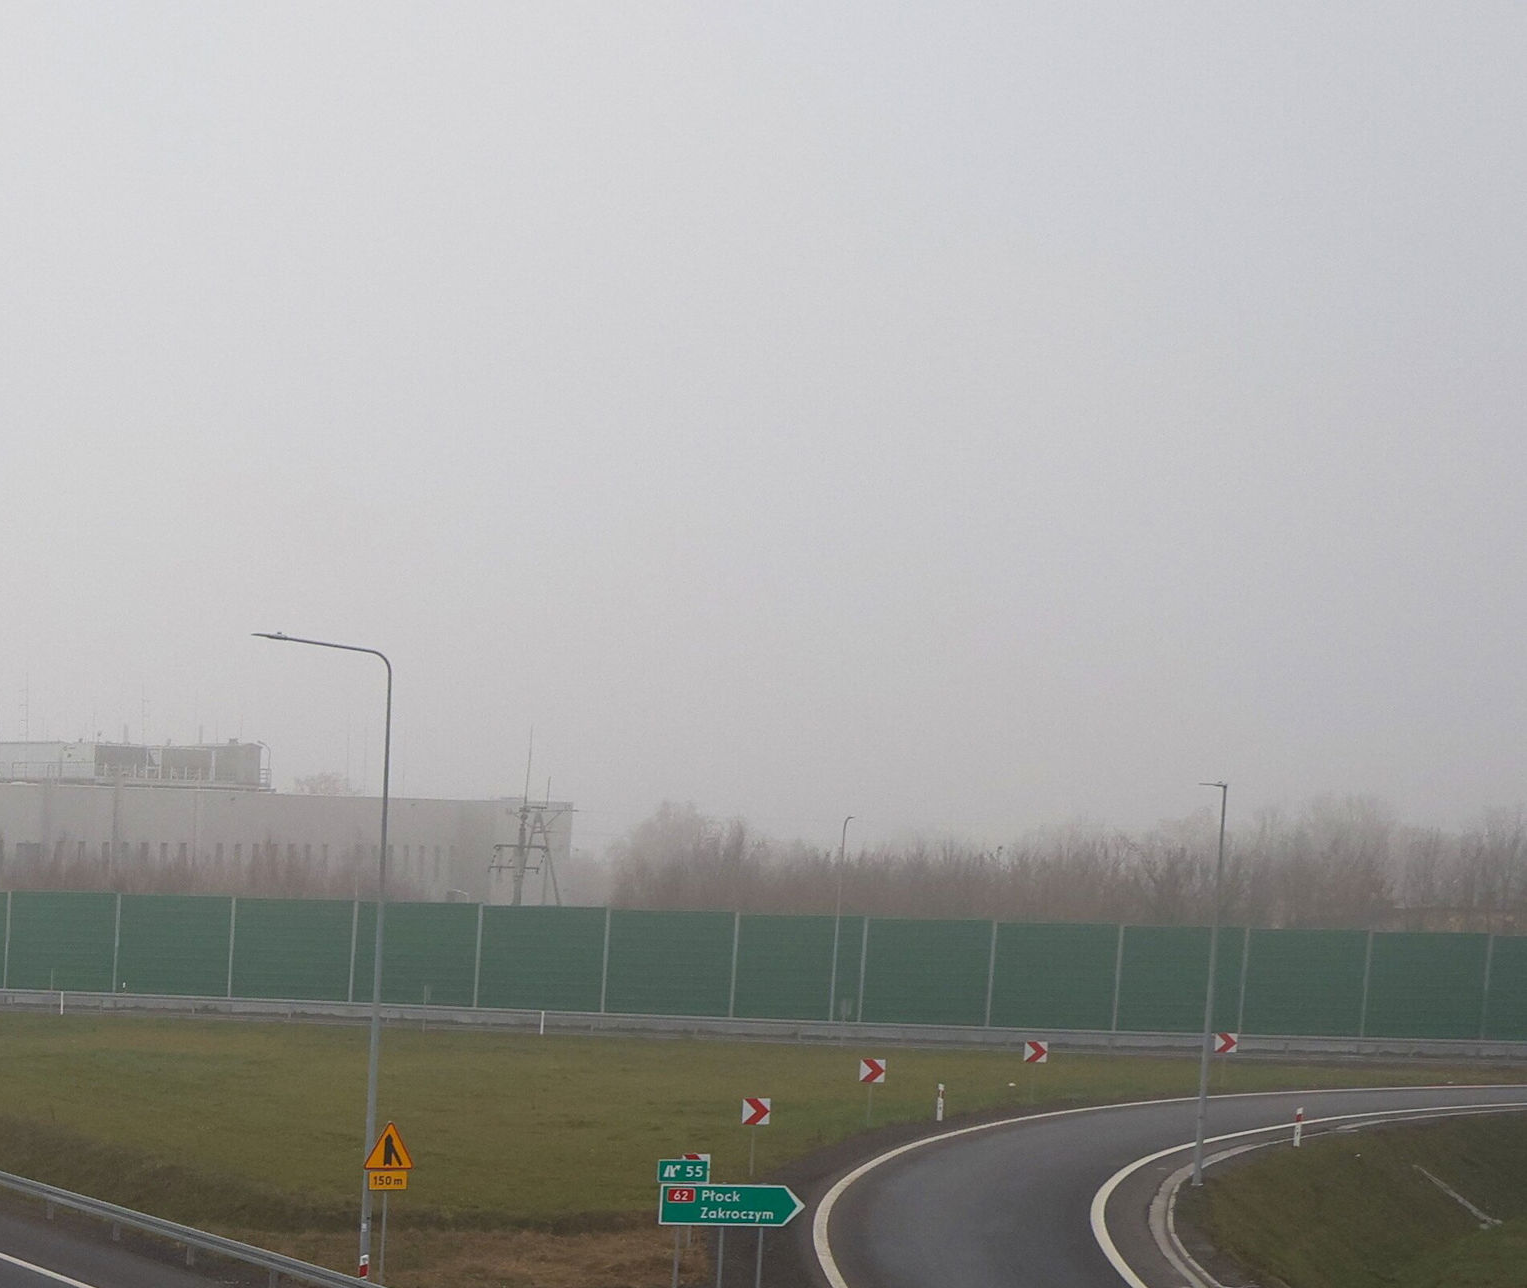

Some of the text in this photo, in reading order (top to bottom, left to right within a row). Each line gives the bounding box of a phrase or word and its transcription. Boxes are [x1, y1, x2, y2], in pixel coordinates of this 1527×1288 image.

[685, 1165, 703, 1178] 55
[373, 1175, 403, 1186] 150 m
[673, 1189, 741, 1202] 62 Płock
[700, 1207, 774, 1222] Zakroczym
